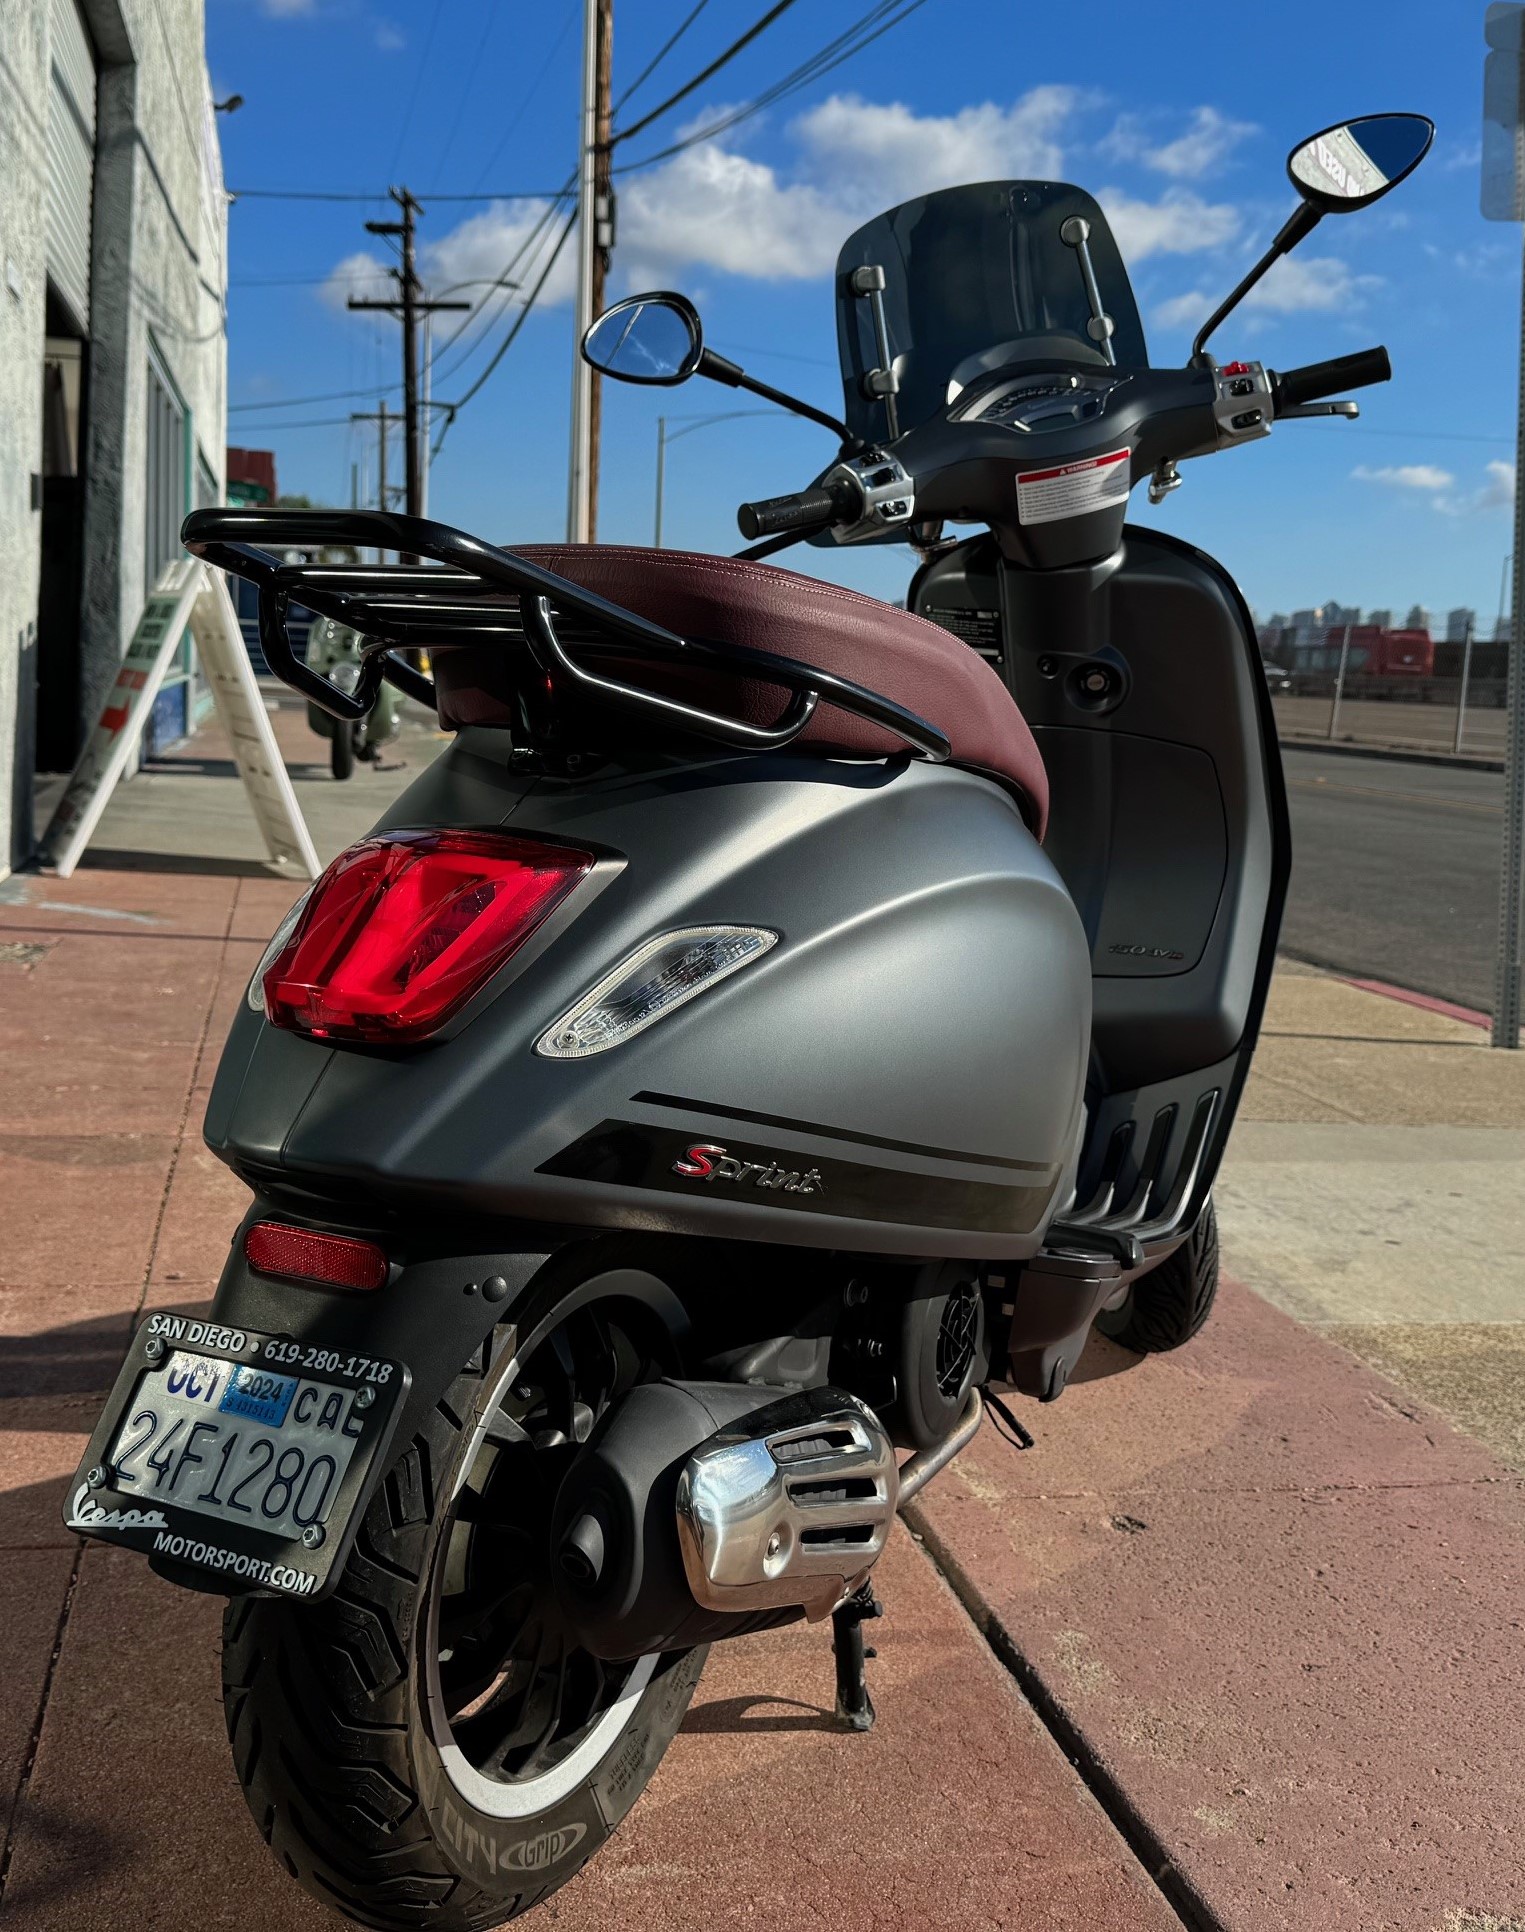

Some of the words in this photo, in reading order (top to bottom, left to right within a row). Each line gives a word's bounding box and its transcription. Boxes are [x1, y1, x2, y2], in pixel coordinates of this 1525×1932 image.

[671, 1144, 822, 1194] Sprint
[147, 1314, 187, 1340] SAN
[187, 1322, 246, 1353] DIEGO
[264, 1340, 394, 1385] 619-280-1718
[239, 1373, 284, 1403] 2024
[113, 1410, 338, 1527] 24F1280
[66, 1482, 169, 1531] Vespa
[153, 1531, 316, 1594] MOTORSPORT.COM
[441, 1797, 497, 1875] CITY
